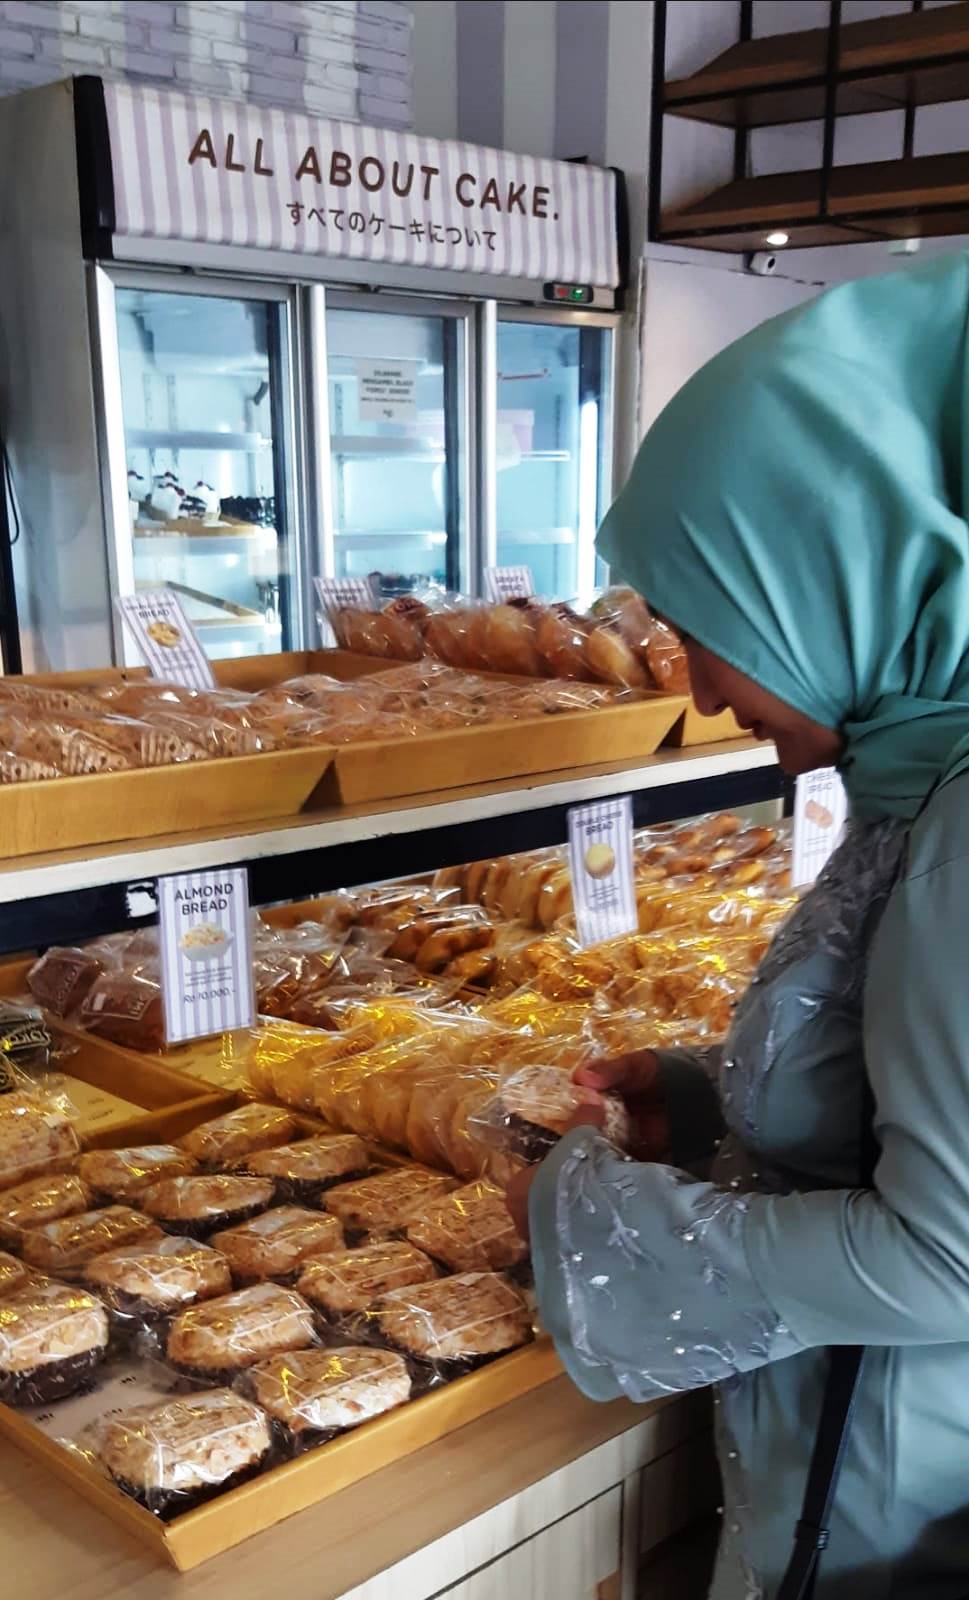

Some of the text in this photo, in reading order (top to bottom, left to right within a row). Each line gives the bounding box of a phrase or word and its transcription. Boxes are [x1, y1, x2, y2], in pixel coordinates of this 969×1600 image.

[188, 128, 559, 221] ALL ABOUT CAKE.
[285, 200, 498, 251] すべてのケーキについて
[586, 821, 614, 836] BREAD
[174, 883, 234, 901] ALMOND
[181, 899, 228, 916] BREAD
